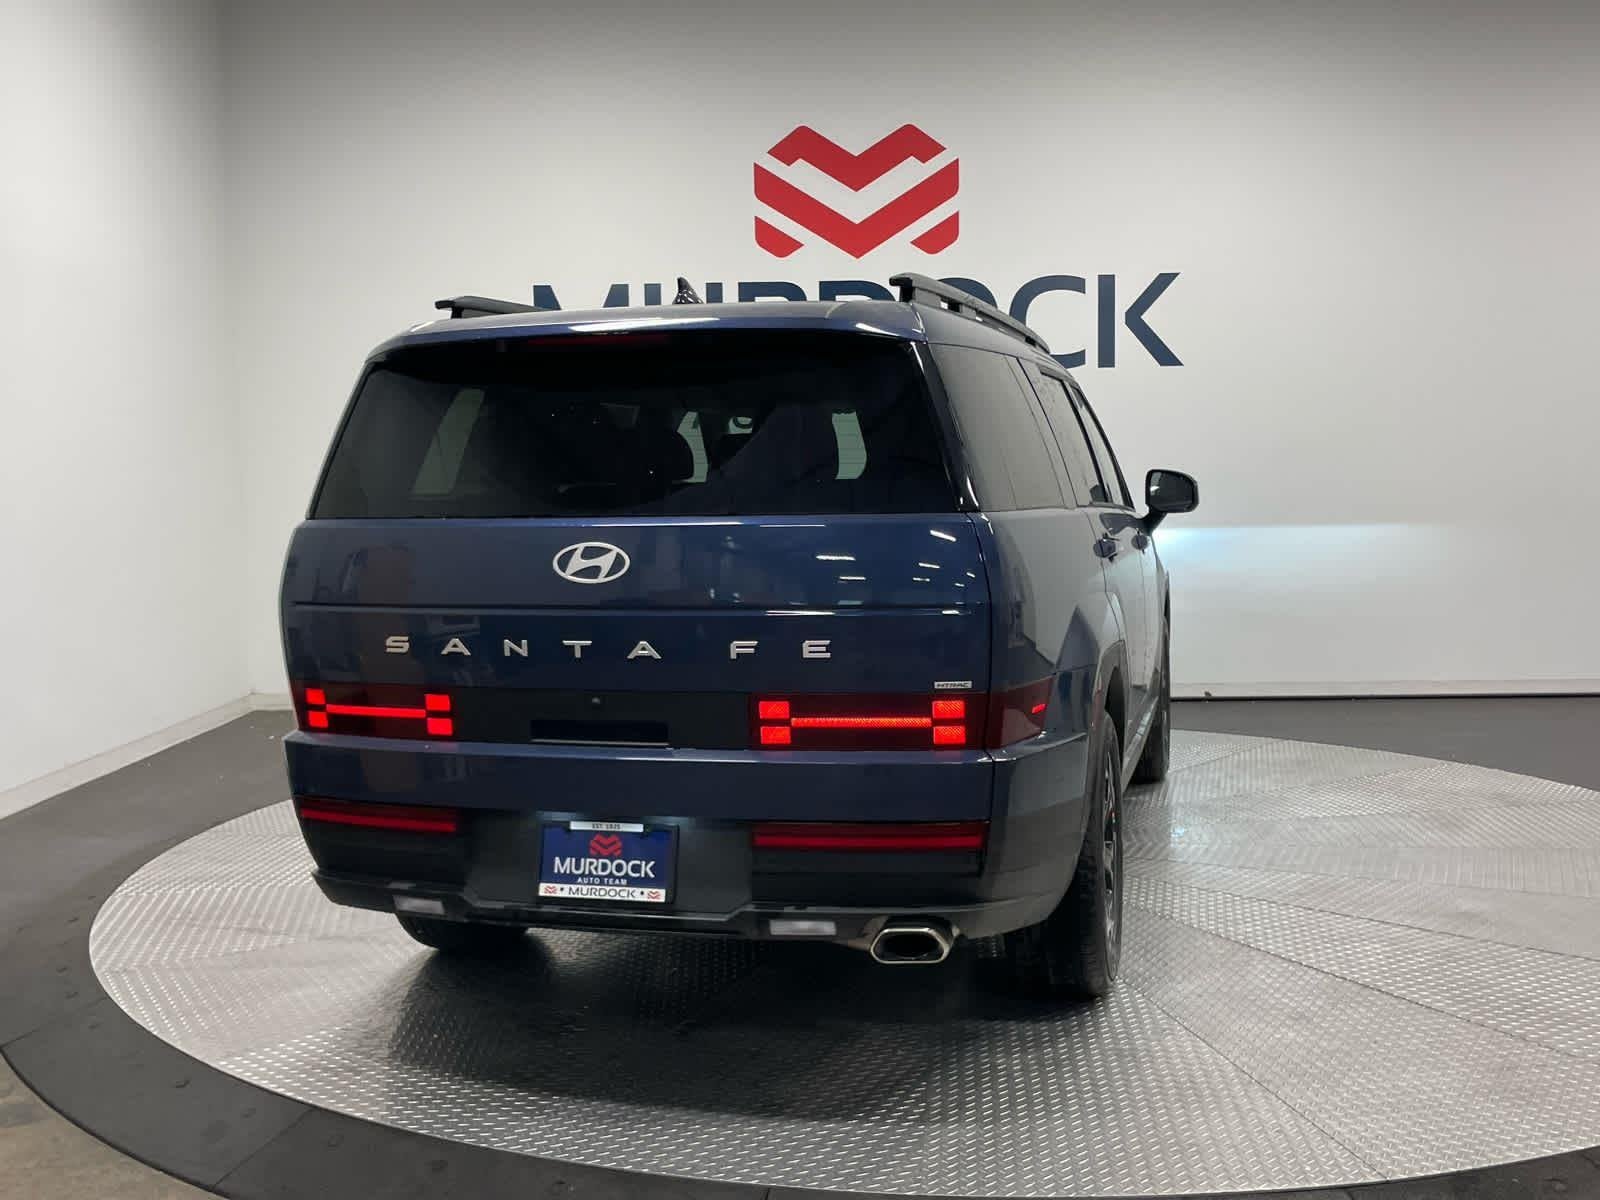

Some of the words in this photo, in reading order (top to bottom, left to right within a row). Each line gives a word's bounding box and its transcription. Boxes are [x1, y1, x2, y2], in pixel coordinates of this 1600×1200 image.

[385, 636, 661, 660] SANTA
[729, 640, 832, 659] FE
[554, 857, 656, 878] MURDOCK
[577, 877, 601, 885] AUTO
[604, 878, 628, 886] TEAM
[568, 886, 636, 899] MURDOCK
